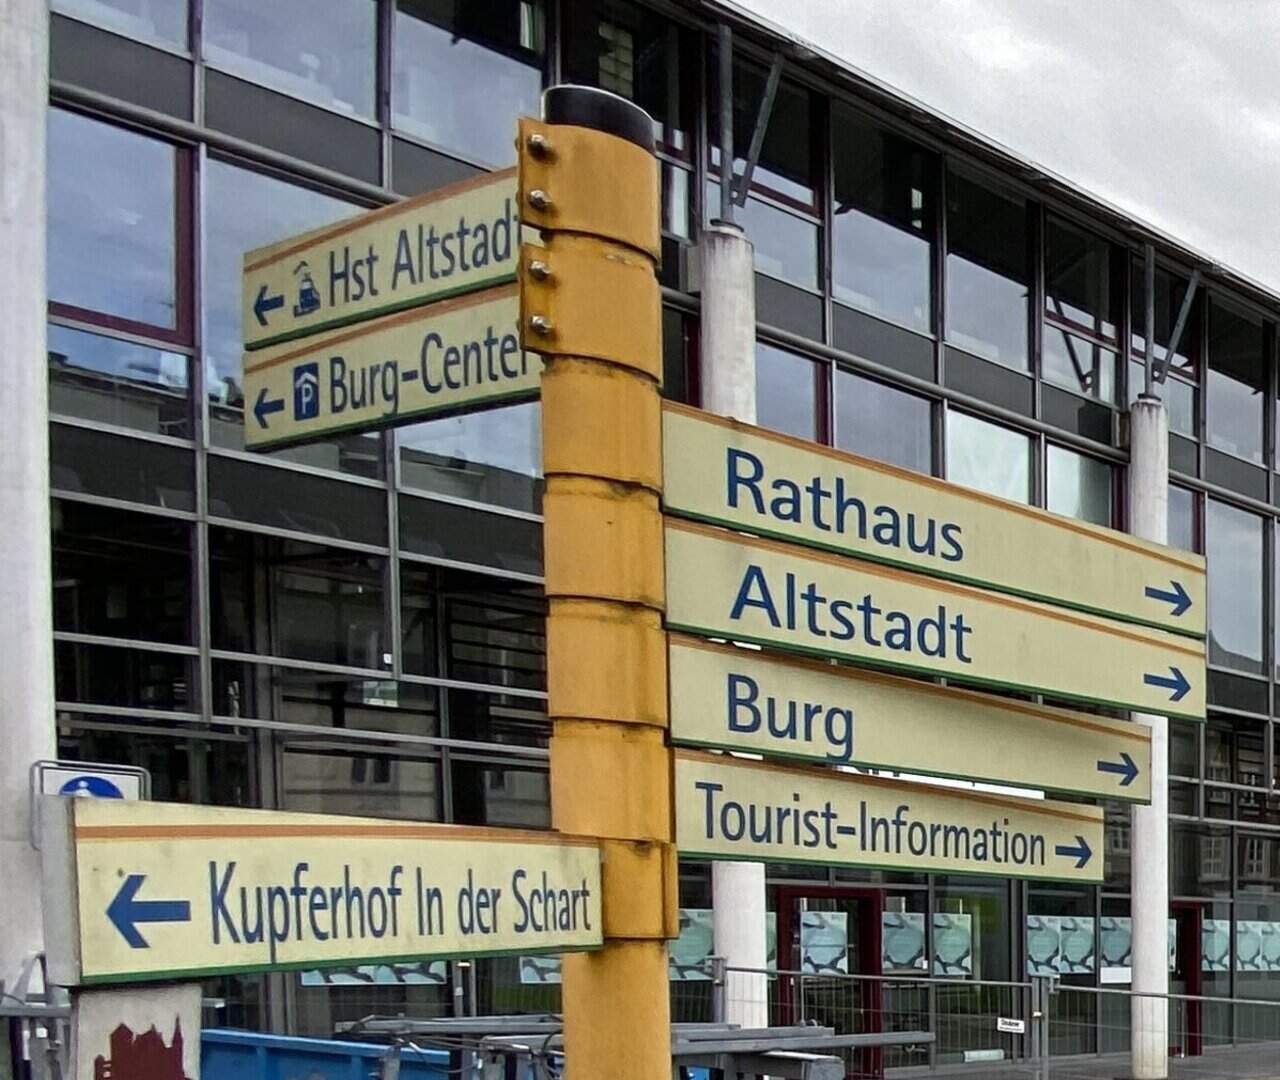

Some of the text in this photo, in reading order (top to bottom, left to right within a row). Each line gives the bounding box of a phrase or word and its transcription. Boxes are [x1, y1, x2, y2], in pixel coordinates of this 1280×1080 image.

[328, 198, 522, 307] Hst Altstad
[727, 448, 963, 561] Rathaus
[730, 565, 972, 663] Altstadt
[728, 673, 854, 763] Burg
[696, 782, 1045, 866] Tourist-Information
[210, 860, 591, 963] Kupferhof In der Schart
